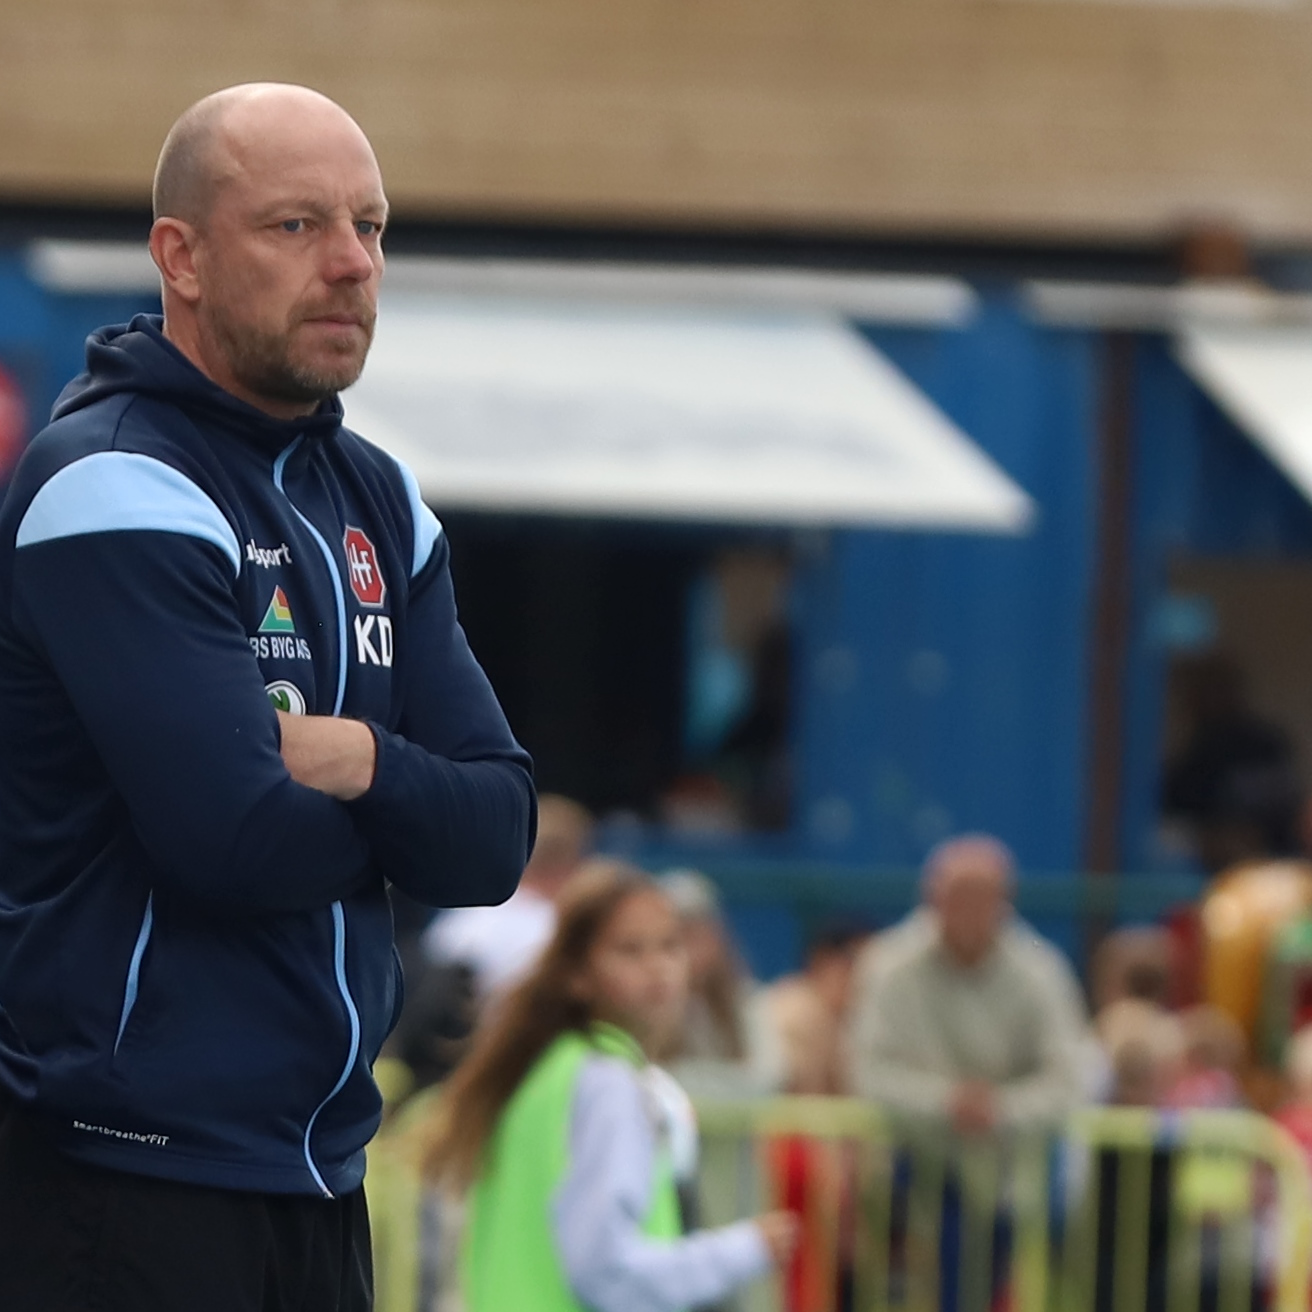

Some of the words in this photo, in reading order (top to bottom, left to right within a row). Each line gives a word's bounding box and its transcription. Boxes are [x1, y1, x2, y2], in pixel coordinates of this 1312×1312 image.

[270, 636, 295, 659] BYG
[295, 637, 312, 660] AS
[354, 614, 393, 668] KD
